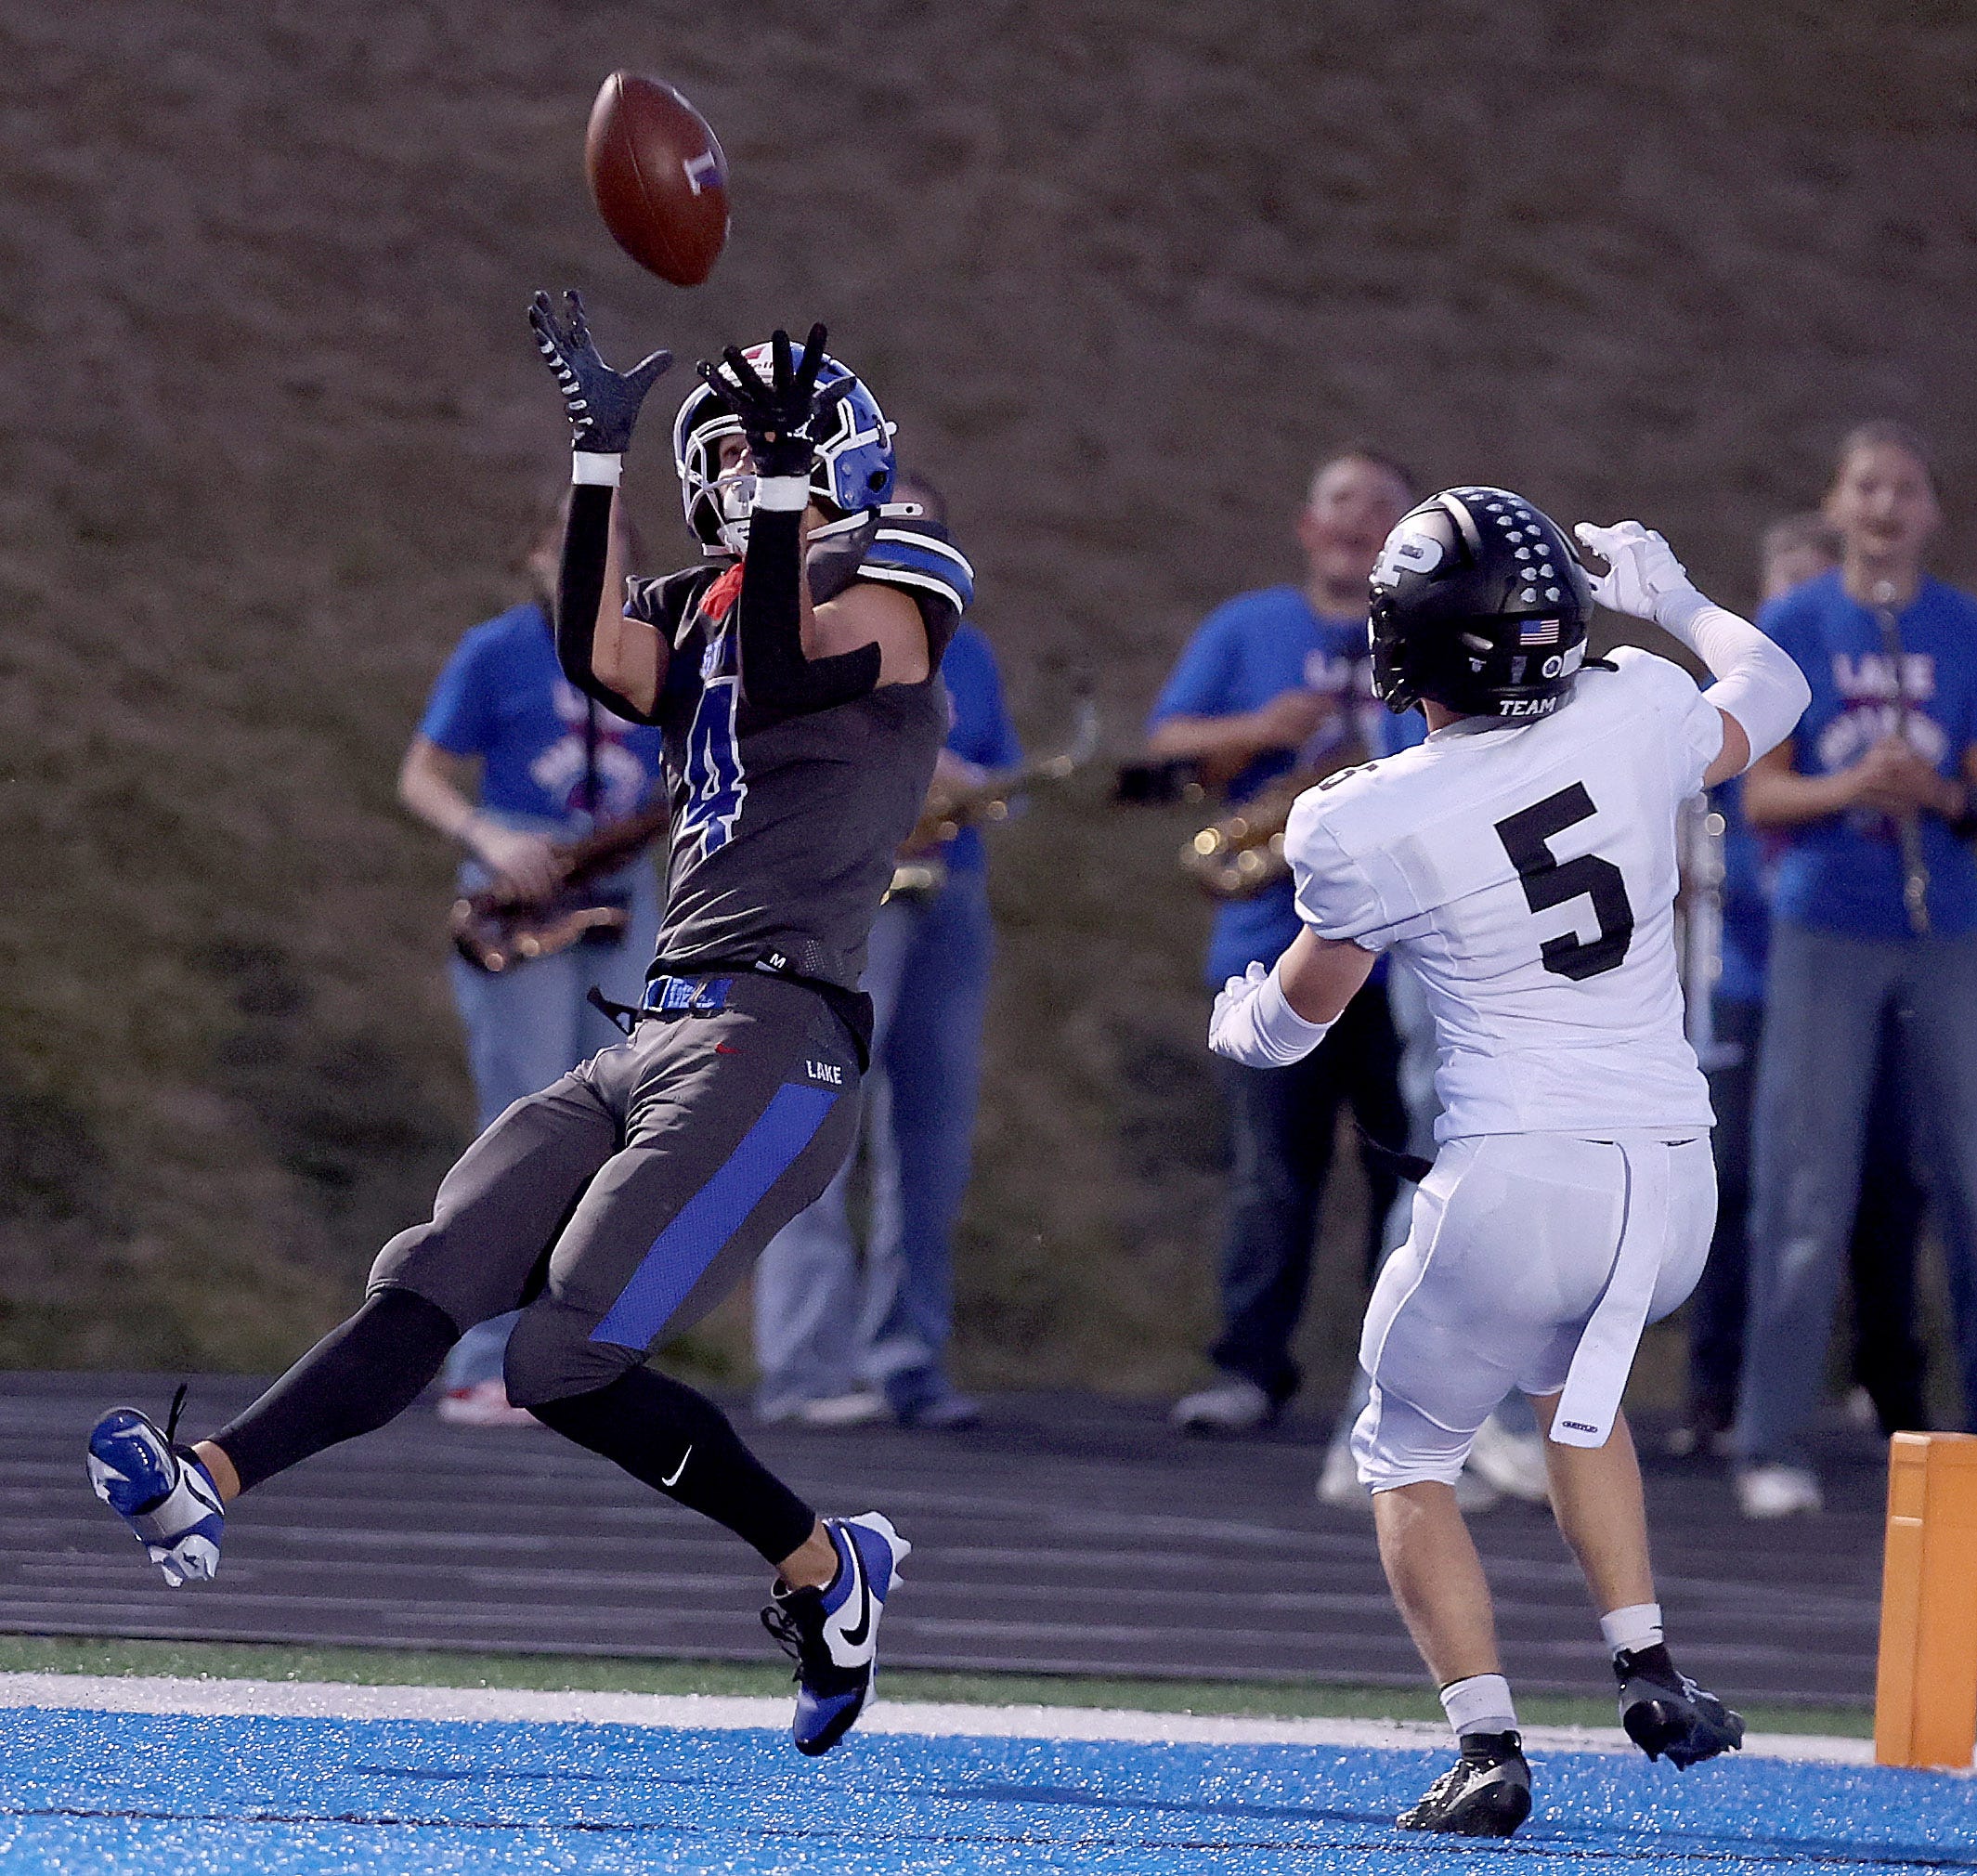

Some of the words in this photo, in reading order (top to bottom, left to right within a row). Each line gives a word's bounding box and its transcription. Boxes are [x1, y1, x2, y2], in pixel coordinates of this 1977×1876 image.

[1500, 697, 1556, 716] TEAM
[672, 676, 748, 860] 4
[1493, 780, 1634, 982] 5
[805, 1060, 842, 1085] LAKE
